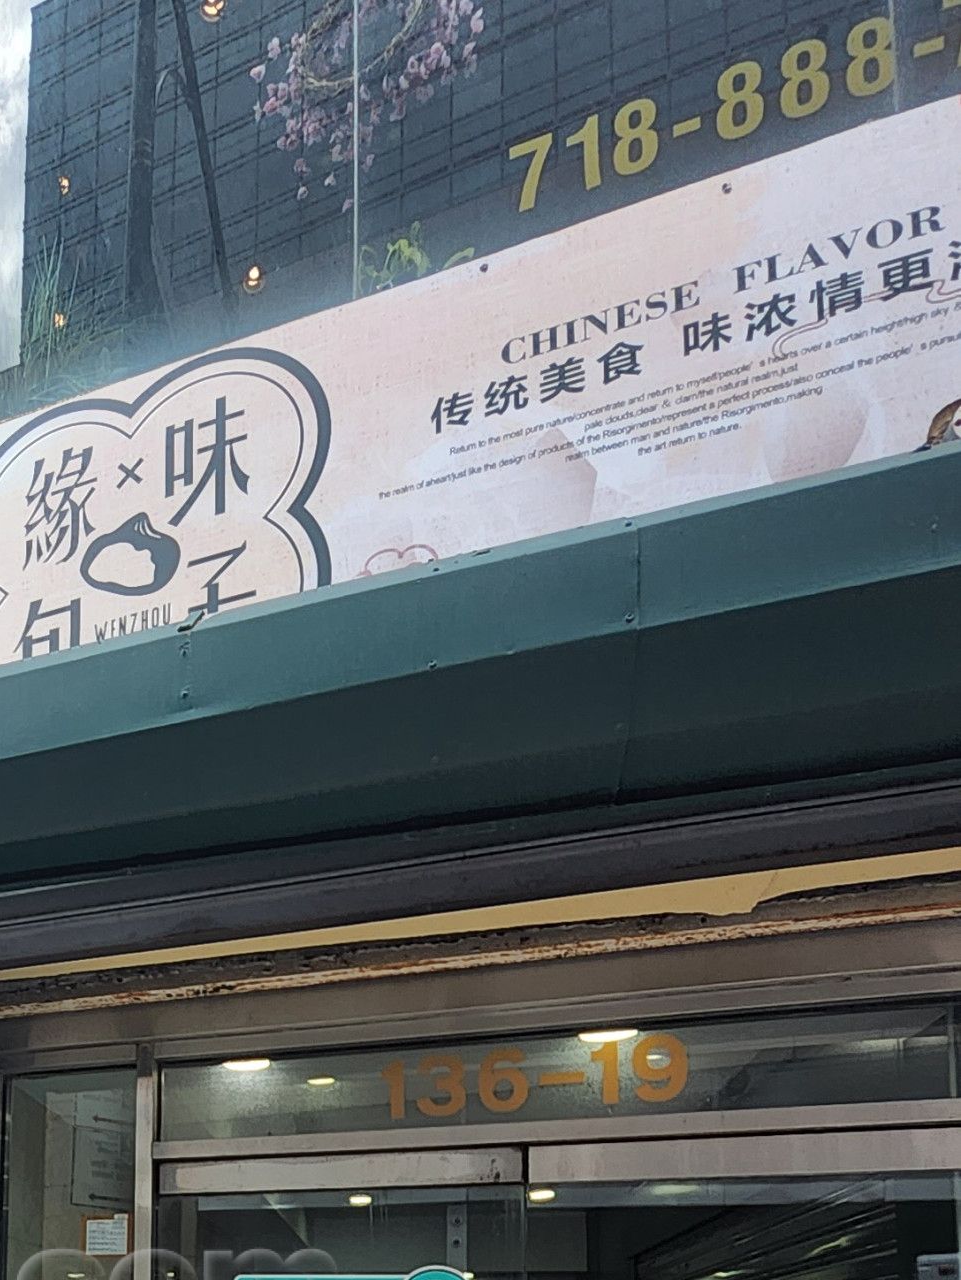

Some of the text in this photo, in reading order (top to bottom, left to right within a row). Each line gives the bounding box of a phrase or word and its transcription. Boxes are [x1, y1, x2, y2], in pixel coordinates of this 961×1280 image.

[508, 16, 961, 213] 718-888-
[501, 205, 946, 364] CHINESE FLAVOR
[378, 491, 391, 500] the
[415, 479, 426, 490] of
[483, 462, 496, 471] the
[498, 454, 526, 467] design
[527, 449, 536, 459] of
[538, 441, 574, 458] products
[575, 435, 585, 446] of
[586, 433, 601, 444] the
[717, 390, 750, 409] perfect
[815, 360, 855, 379] conceal
[857, 357, 874, 368] the
[430, 340, 645, 434] 传统美食
[449, 442, 477, 455] Return
[478, 440, 487, 448] to
[487, 436, 501, 445] the
[502, 428, 523, 440] most
[524, 423, 544, 436] pure
[628, 394, 644, 405] and
[646, 386, 674, 399] return
[675, 383, 685, 392] to
[801, 342, 822, 355] over
[824, 340, 831, 349] a
[834, 330, 868, 345] certain
[584, 419, 603, 432] pale
[716, 376, 749, 393] natural
[591, 439, 629, 455] between
[630, 433, 651, 444] man
[652, 425, 670, 438] and
[637, 446, 652, 456] the
[654, 441, 666, 451] art
[668, 434, 695, 447] return
[697, 431, 707, 440] to
[94, 603, 172, 645] WENZHOU
[380, 1033, 689, 1120] 136-19
